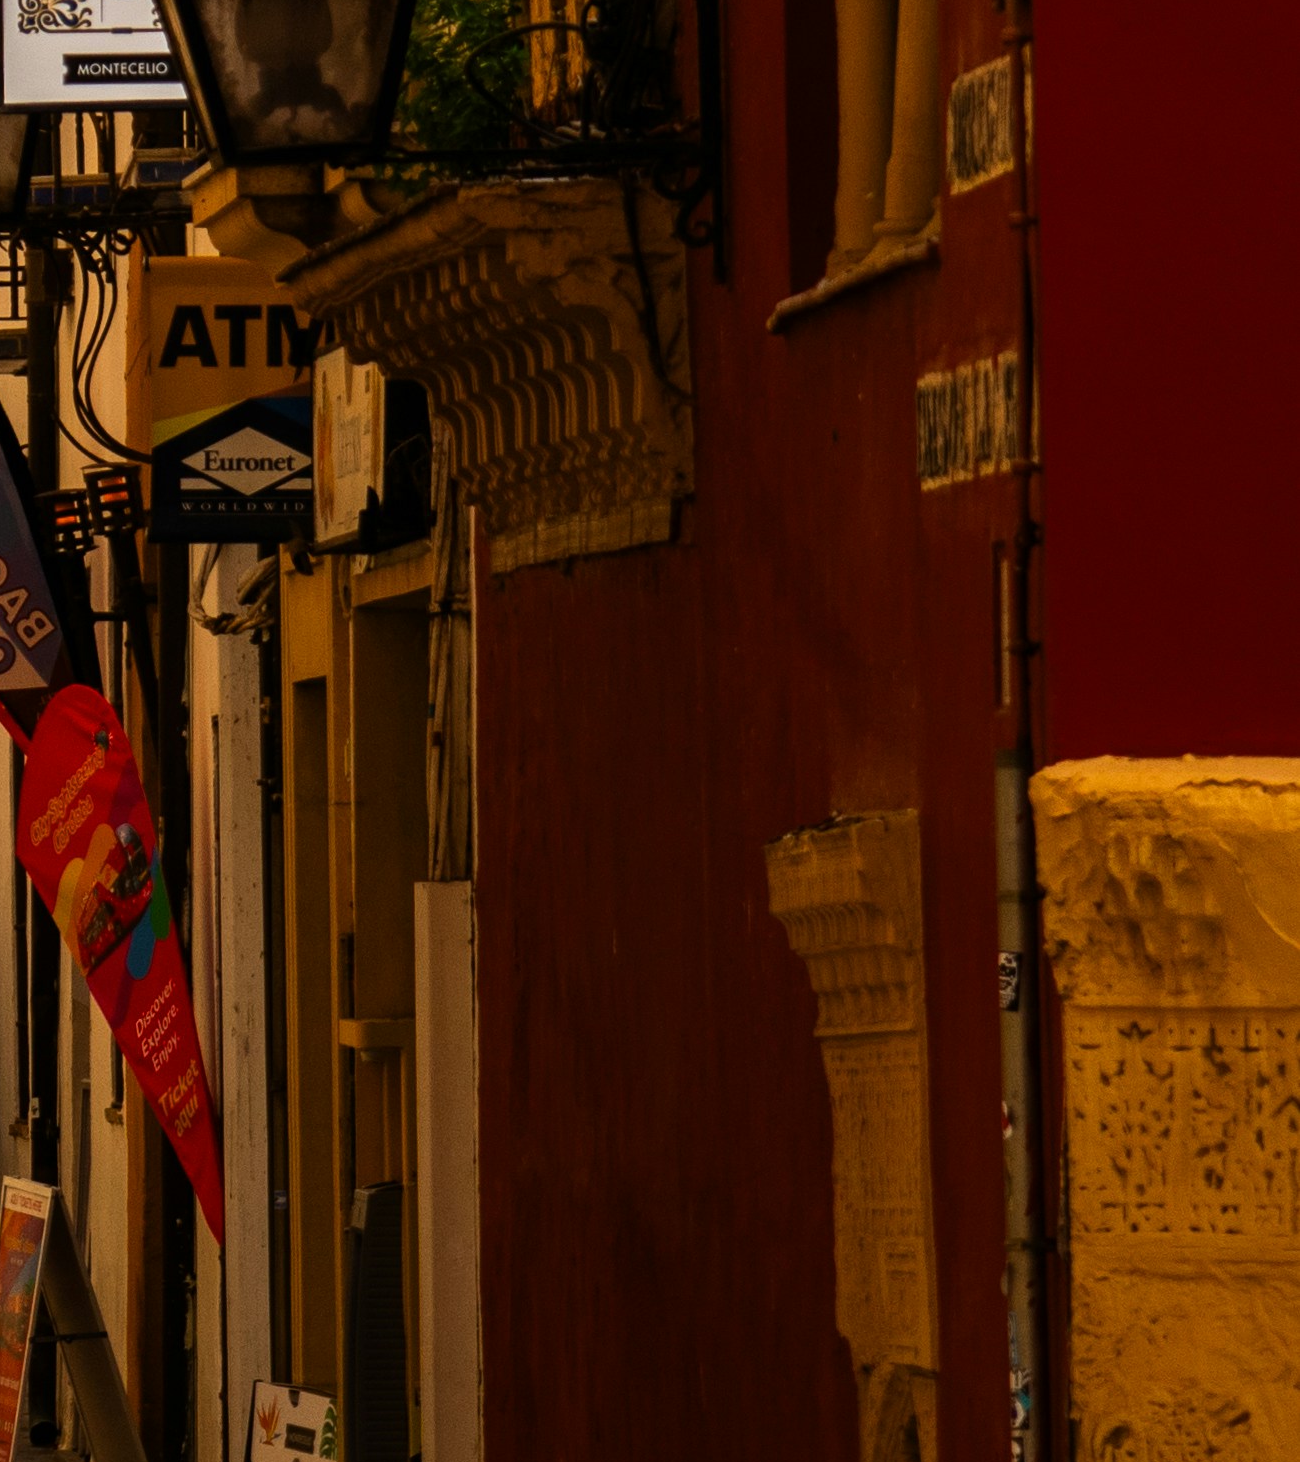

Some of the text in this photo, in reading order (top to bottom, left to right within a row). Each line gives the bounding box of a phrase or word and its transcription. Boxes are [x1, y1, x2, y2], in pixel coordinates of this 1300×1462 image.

[77, 61, 168, 76] MONTECELIO
[202, 450, 296, 472] Euronet
[181, 501, 305, 512] WORLDWID
[136, 978, 176, 1038] Discover.
[142, 1004, 178, 1058] Explore.
[152, 1031, 180, 1072] Enjoy.
[158, 1058, 199, 1117] Ticket
